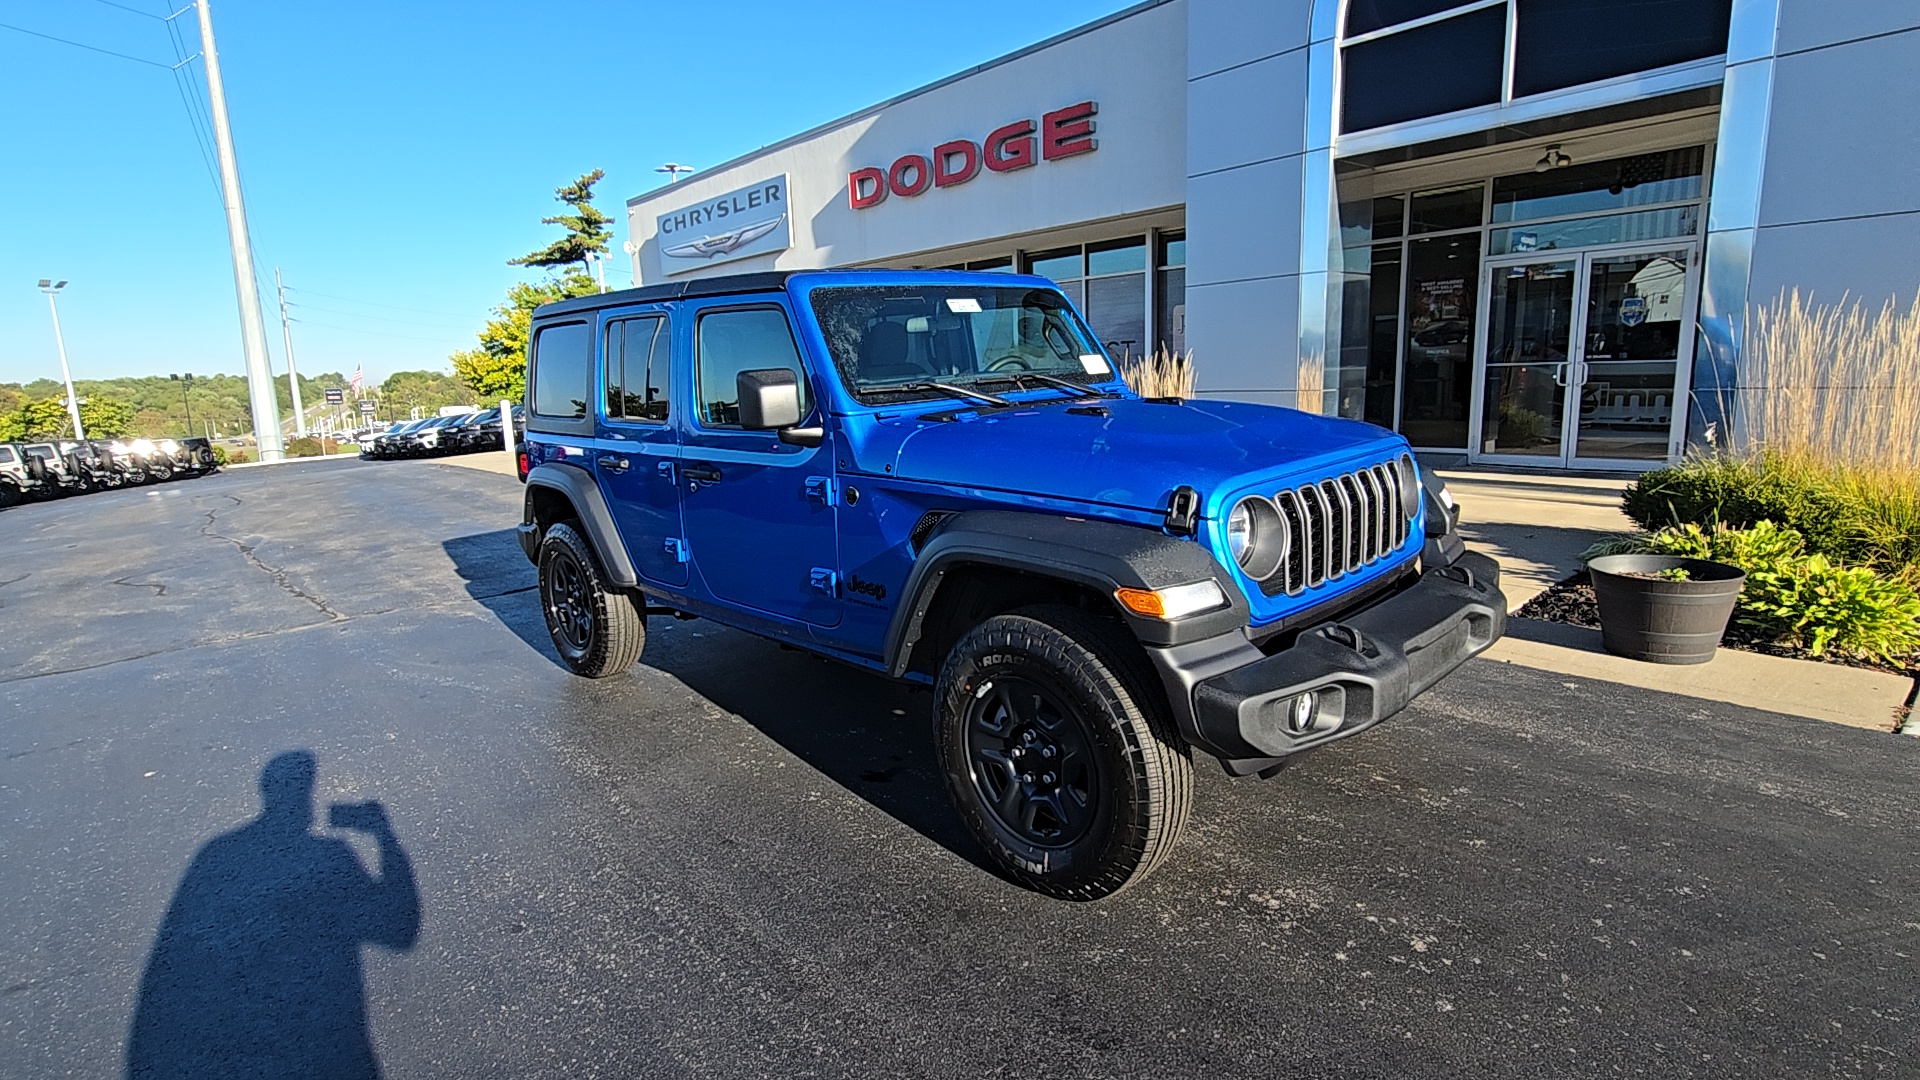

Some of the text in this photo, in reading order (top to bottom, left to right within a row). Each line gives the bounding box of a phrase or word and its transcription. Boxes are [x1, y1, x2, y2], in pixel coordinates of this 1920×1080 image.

[848, 100, 1098, 210] DODGE
[661, 184, 781, 234] CHRYSLER
[846, 574, 887, 601] Jeep
